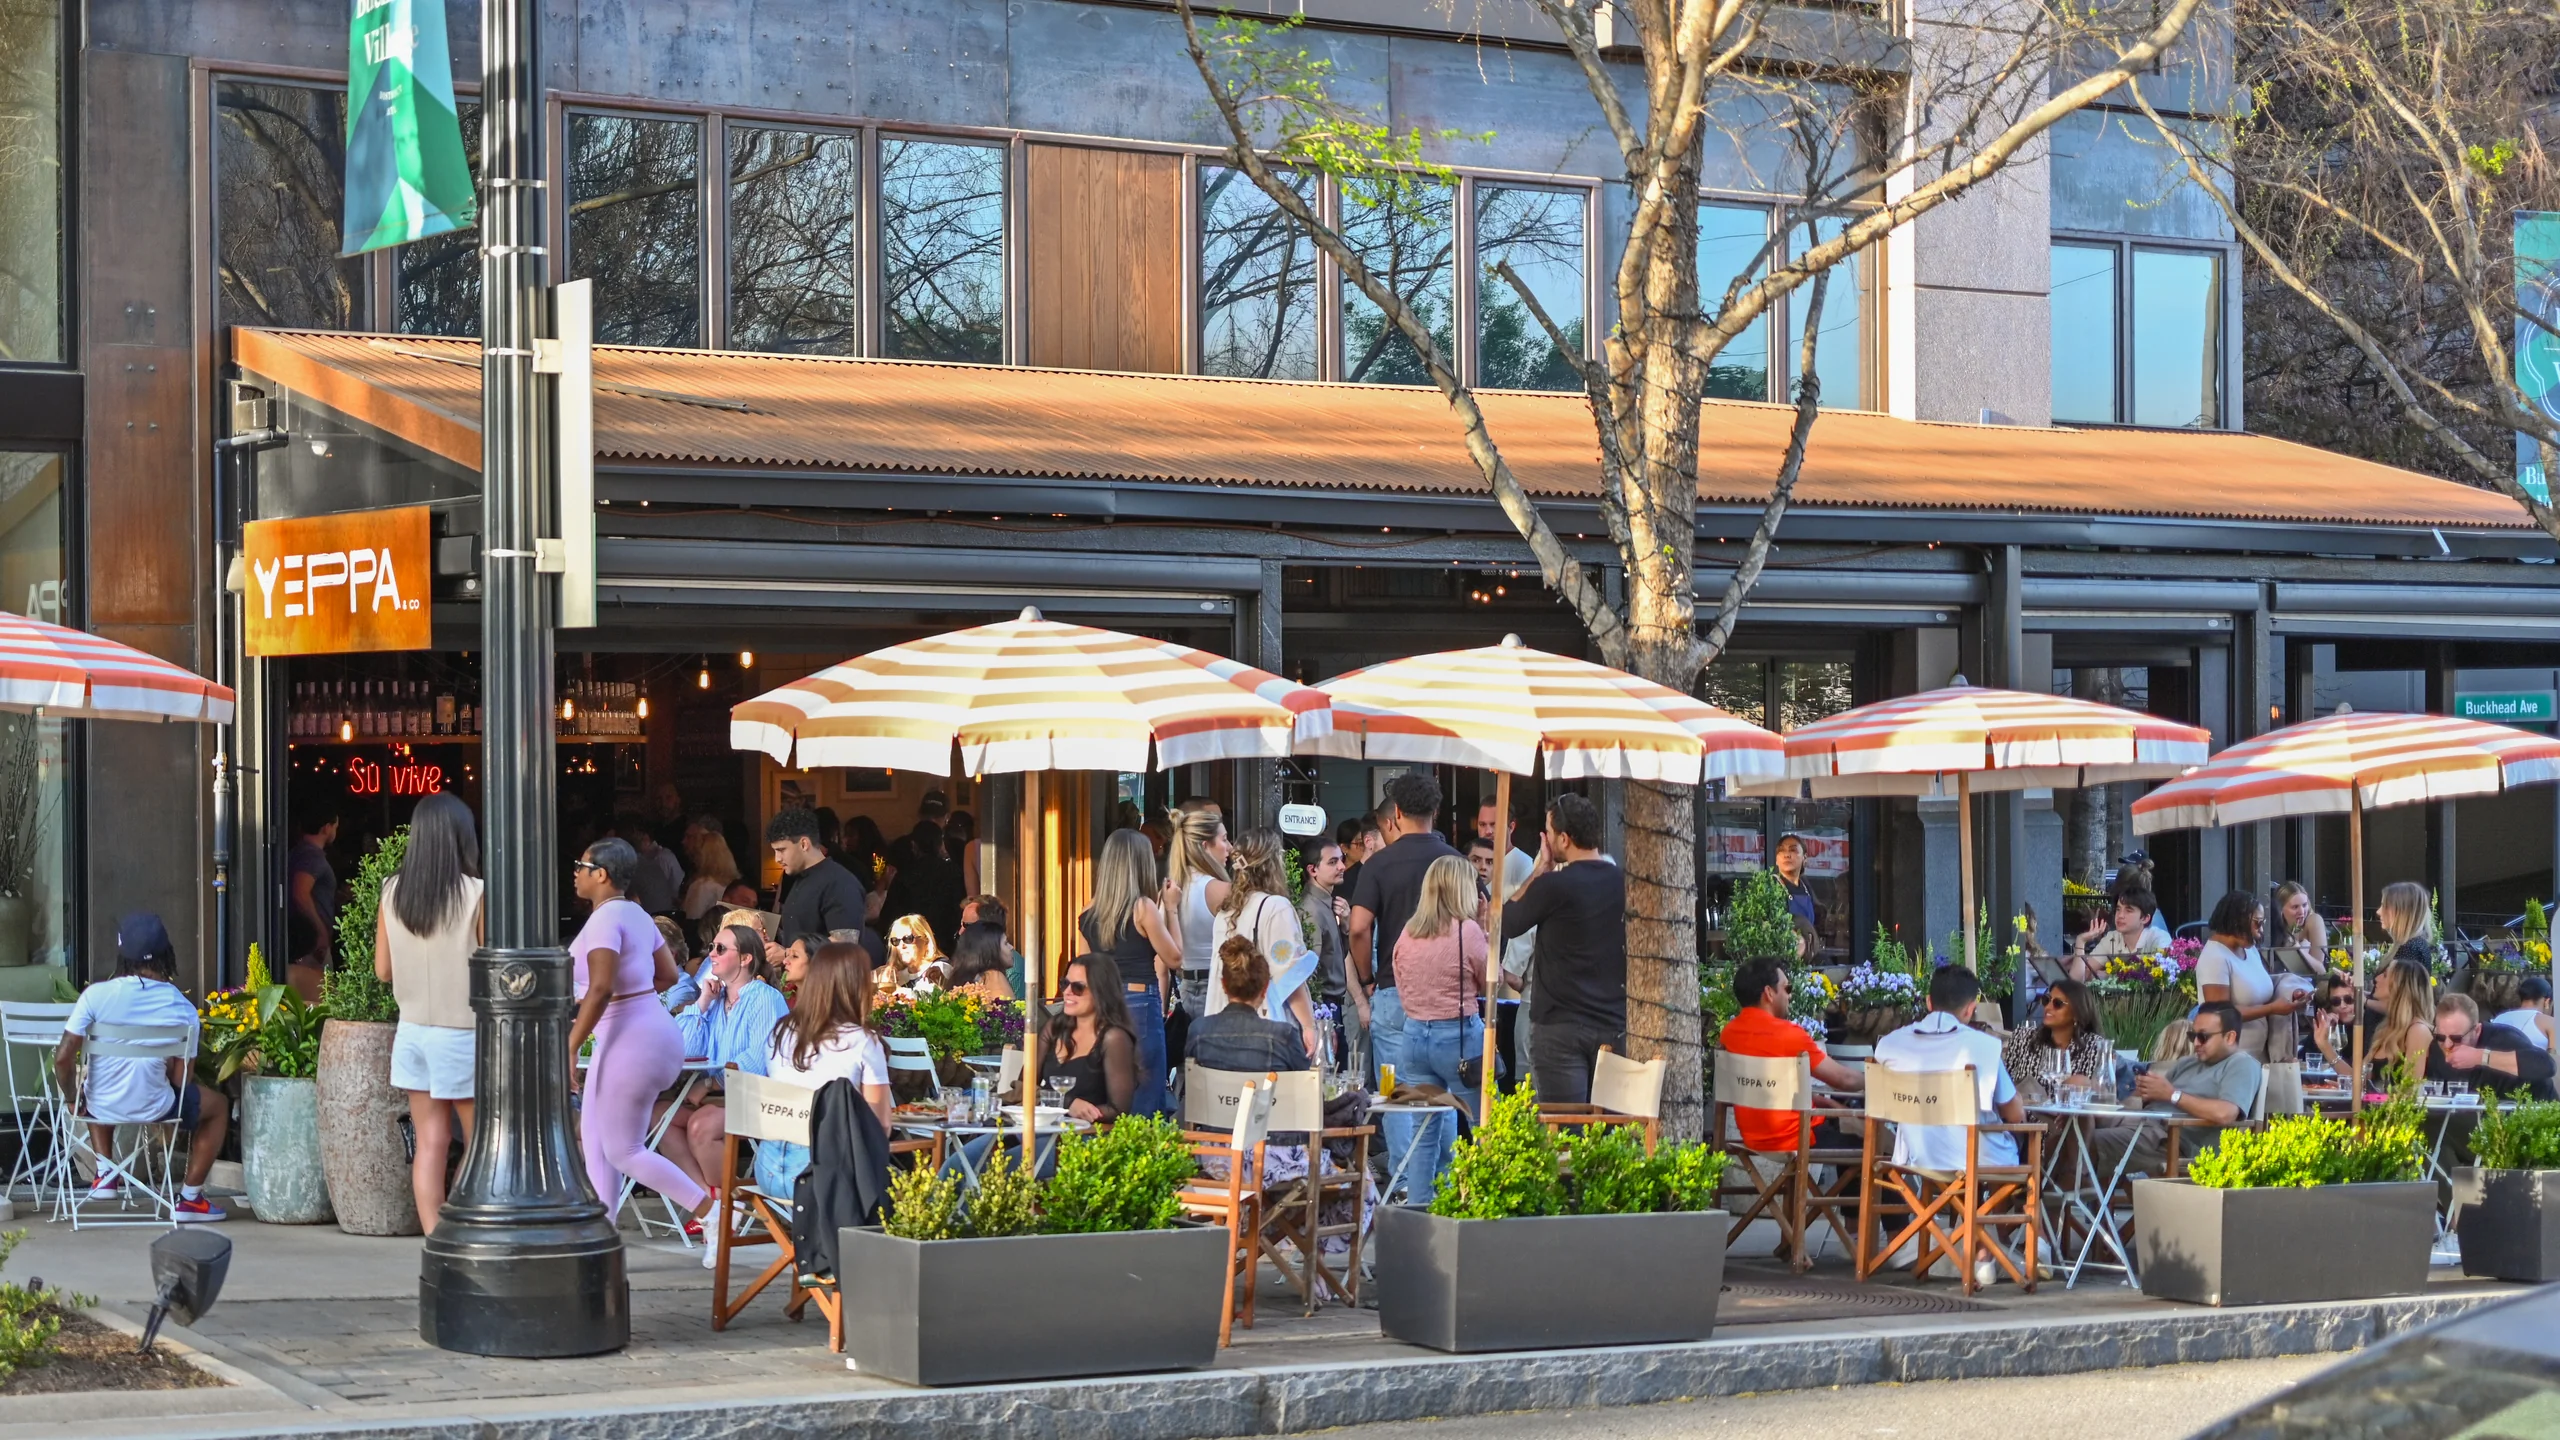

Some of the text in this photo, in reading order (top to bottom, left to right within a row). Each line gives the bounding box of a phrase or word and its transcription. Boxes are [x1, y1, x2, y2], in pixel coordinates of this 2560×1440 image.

[253, 547, 401, 619] YEPPA
[2465, 699, 2538, 715] Buckhead Ave
[1284, 814, 1317, 825] ENTRANCE
[1736, 1076, 1777, 1088] YEPPA 69
[1218, 1094, 1240, 1106] YEP
[1893, 1091, 1938, 1104] YEPPA 69
[760, 1102, 810, 1119] YEPPA 69
